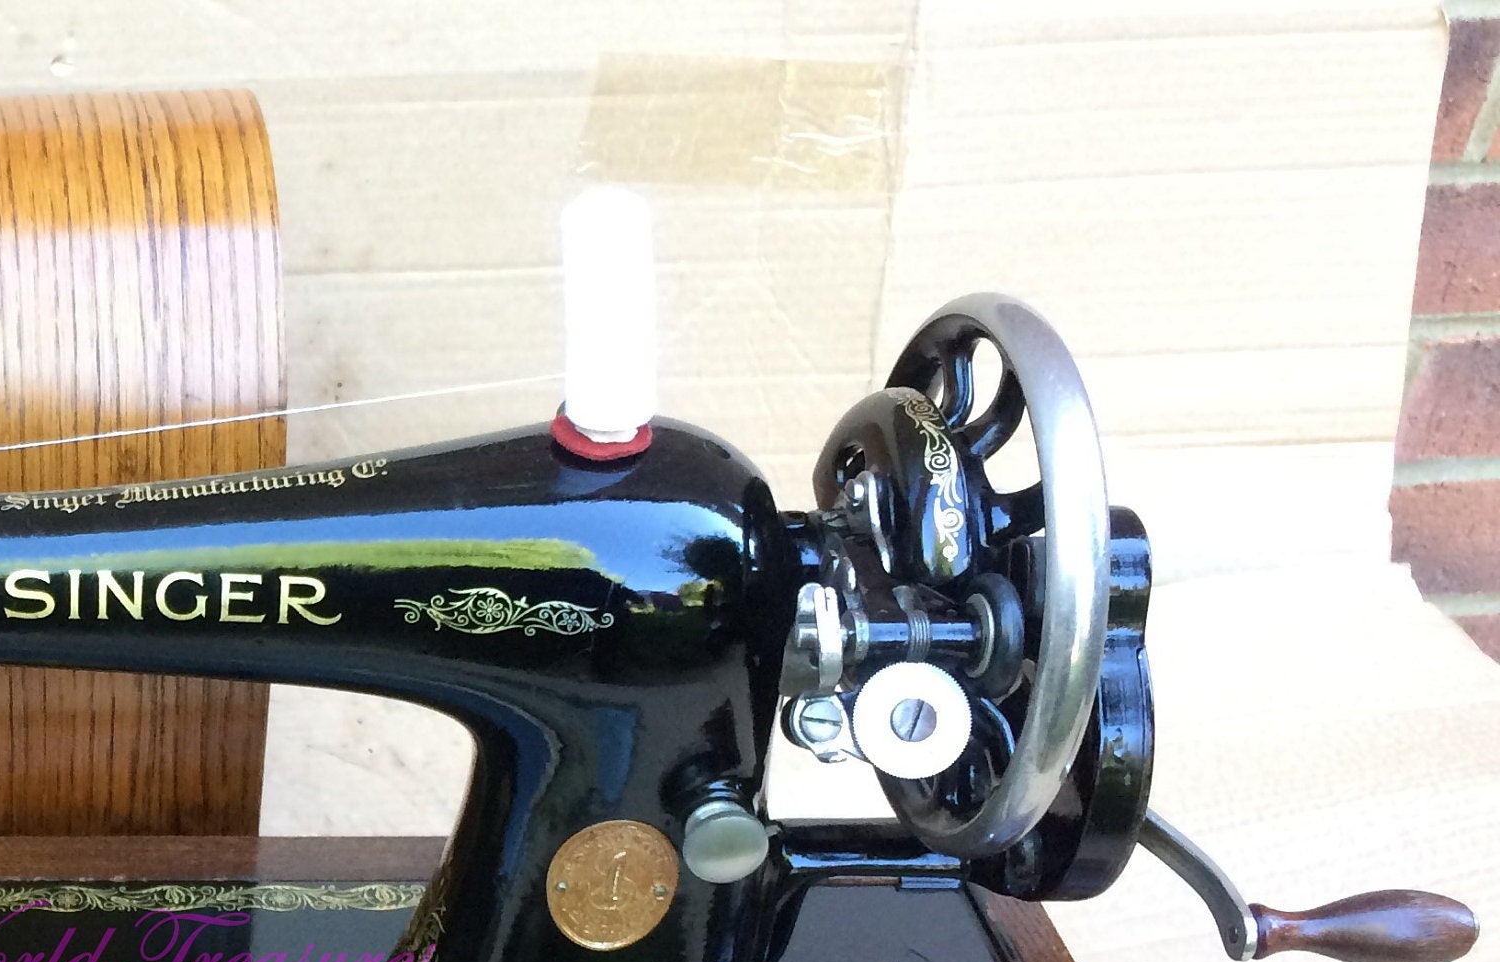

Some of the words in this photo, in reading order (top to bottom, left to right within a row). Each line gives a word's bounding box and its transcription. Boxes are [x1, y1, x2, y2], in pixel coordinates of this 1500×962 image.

[0, 493, 111, 514] Singer
[114, 468, 346, 510] Manufacturing
[3, 569, 343, 626] SINGER
